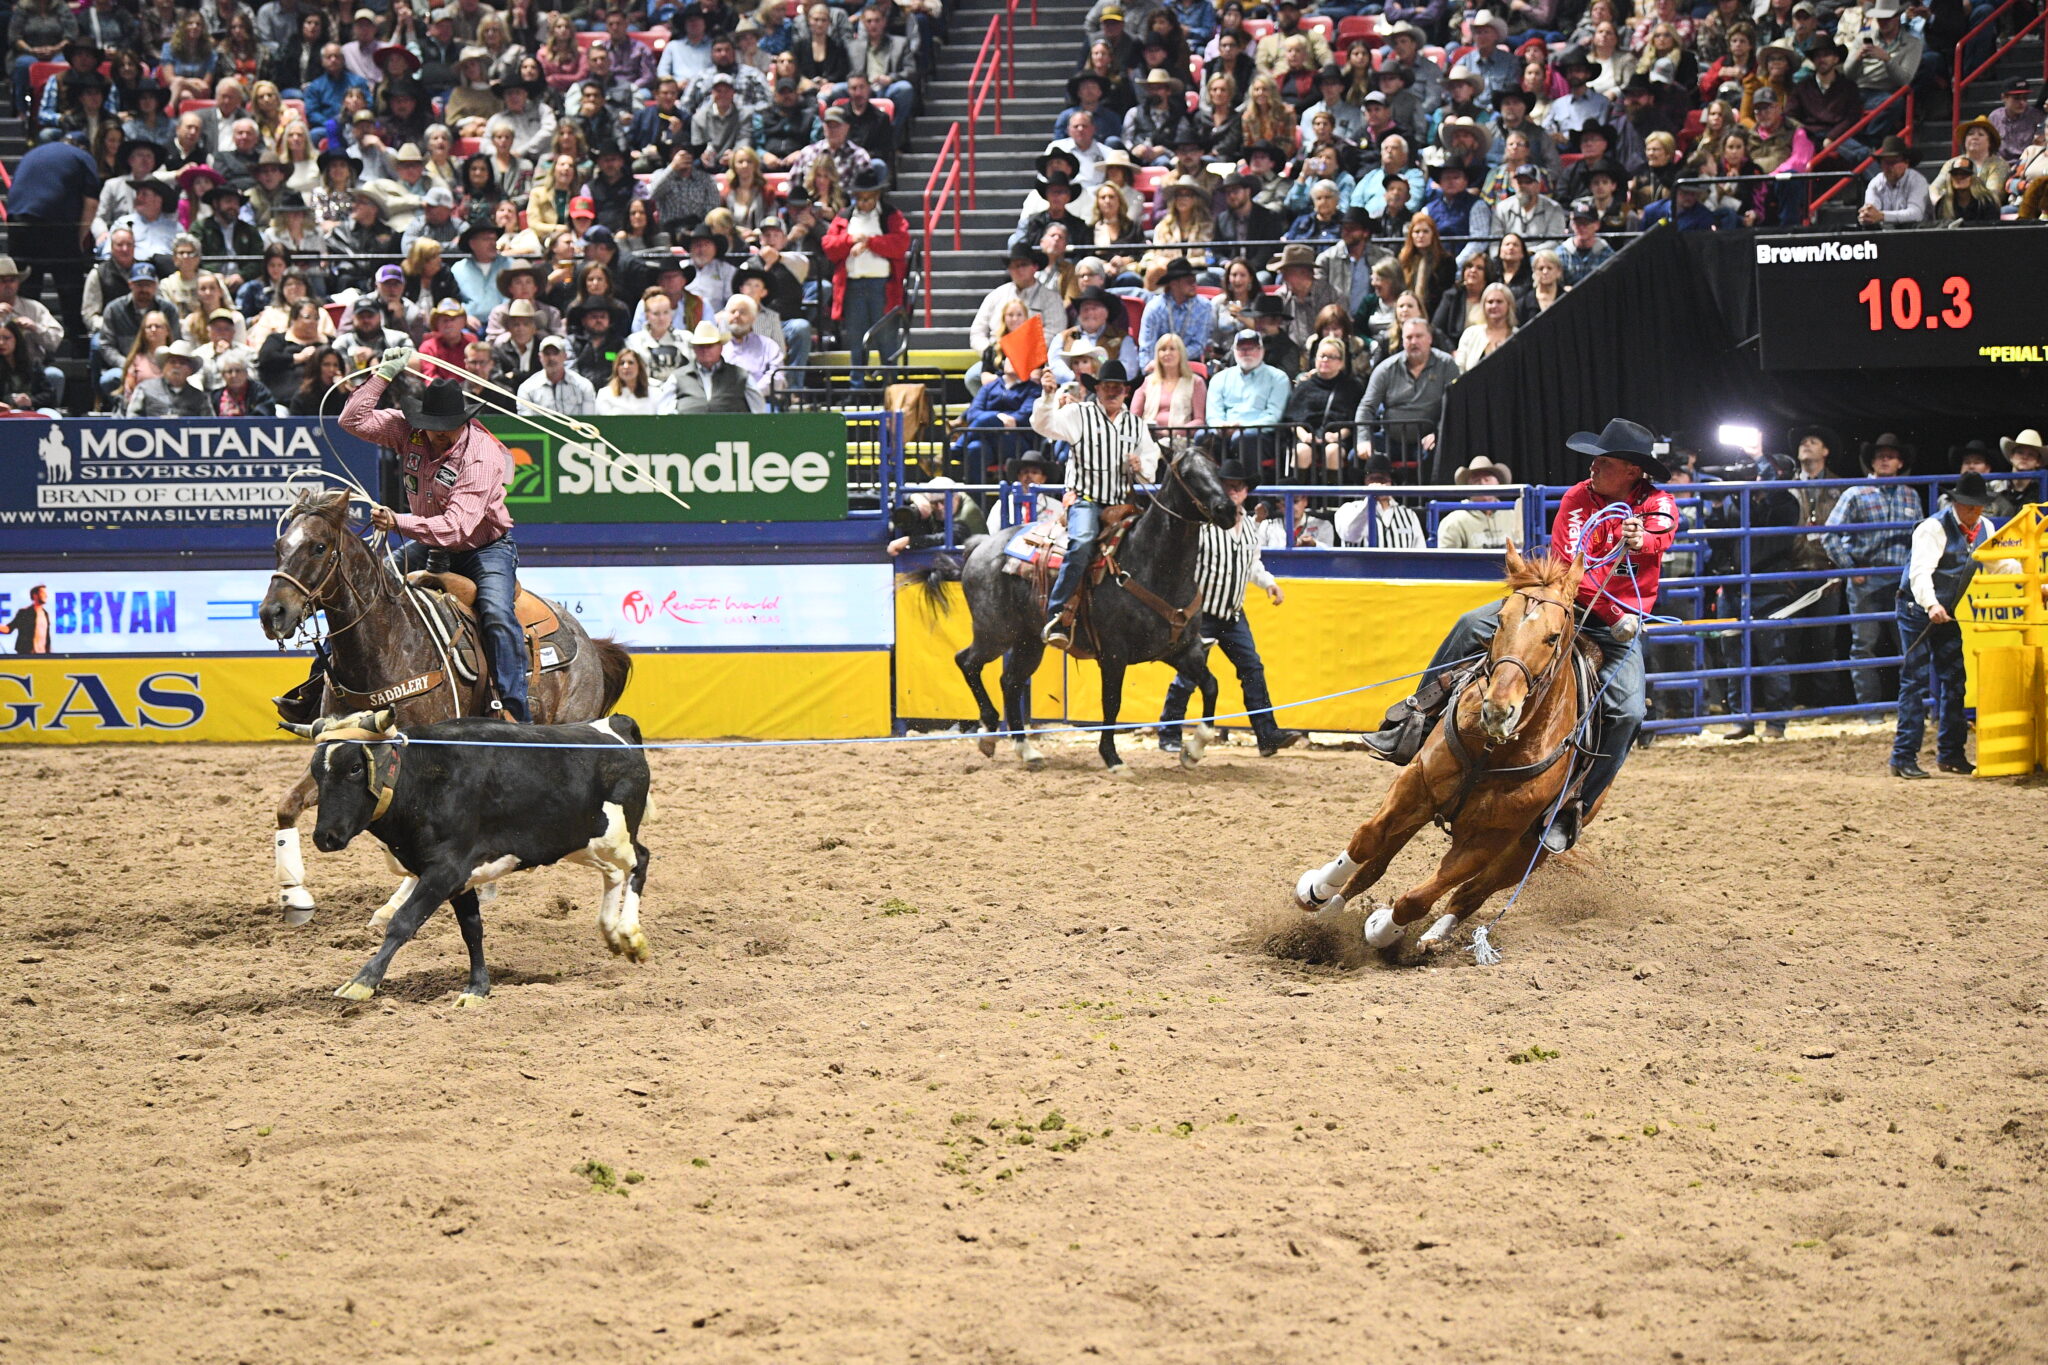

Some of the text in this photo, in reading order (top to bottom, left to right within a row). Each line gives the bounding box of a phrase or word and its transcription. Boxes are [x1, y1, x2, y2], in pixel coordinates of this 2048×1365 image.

[1757, 240, 1878, 264] Brown/Koch
[1859, 276, 1973, 331] 10.3
[80, 427, 320, 459] MONTANA
[80, 463, 321, 479] SILVERSMITHS
[558, 441, 830, 494] Standlee
[42, 486, 311, 504] BRAND OF CHAMPION
[55, 591, 176, 634] BRYAN
[575, 601, 583, 613] 6
[725, 595, 781, 610] World
[369, 674, 430, 706] SADDLERY
